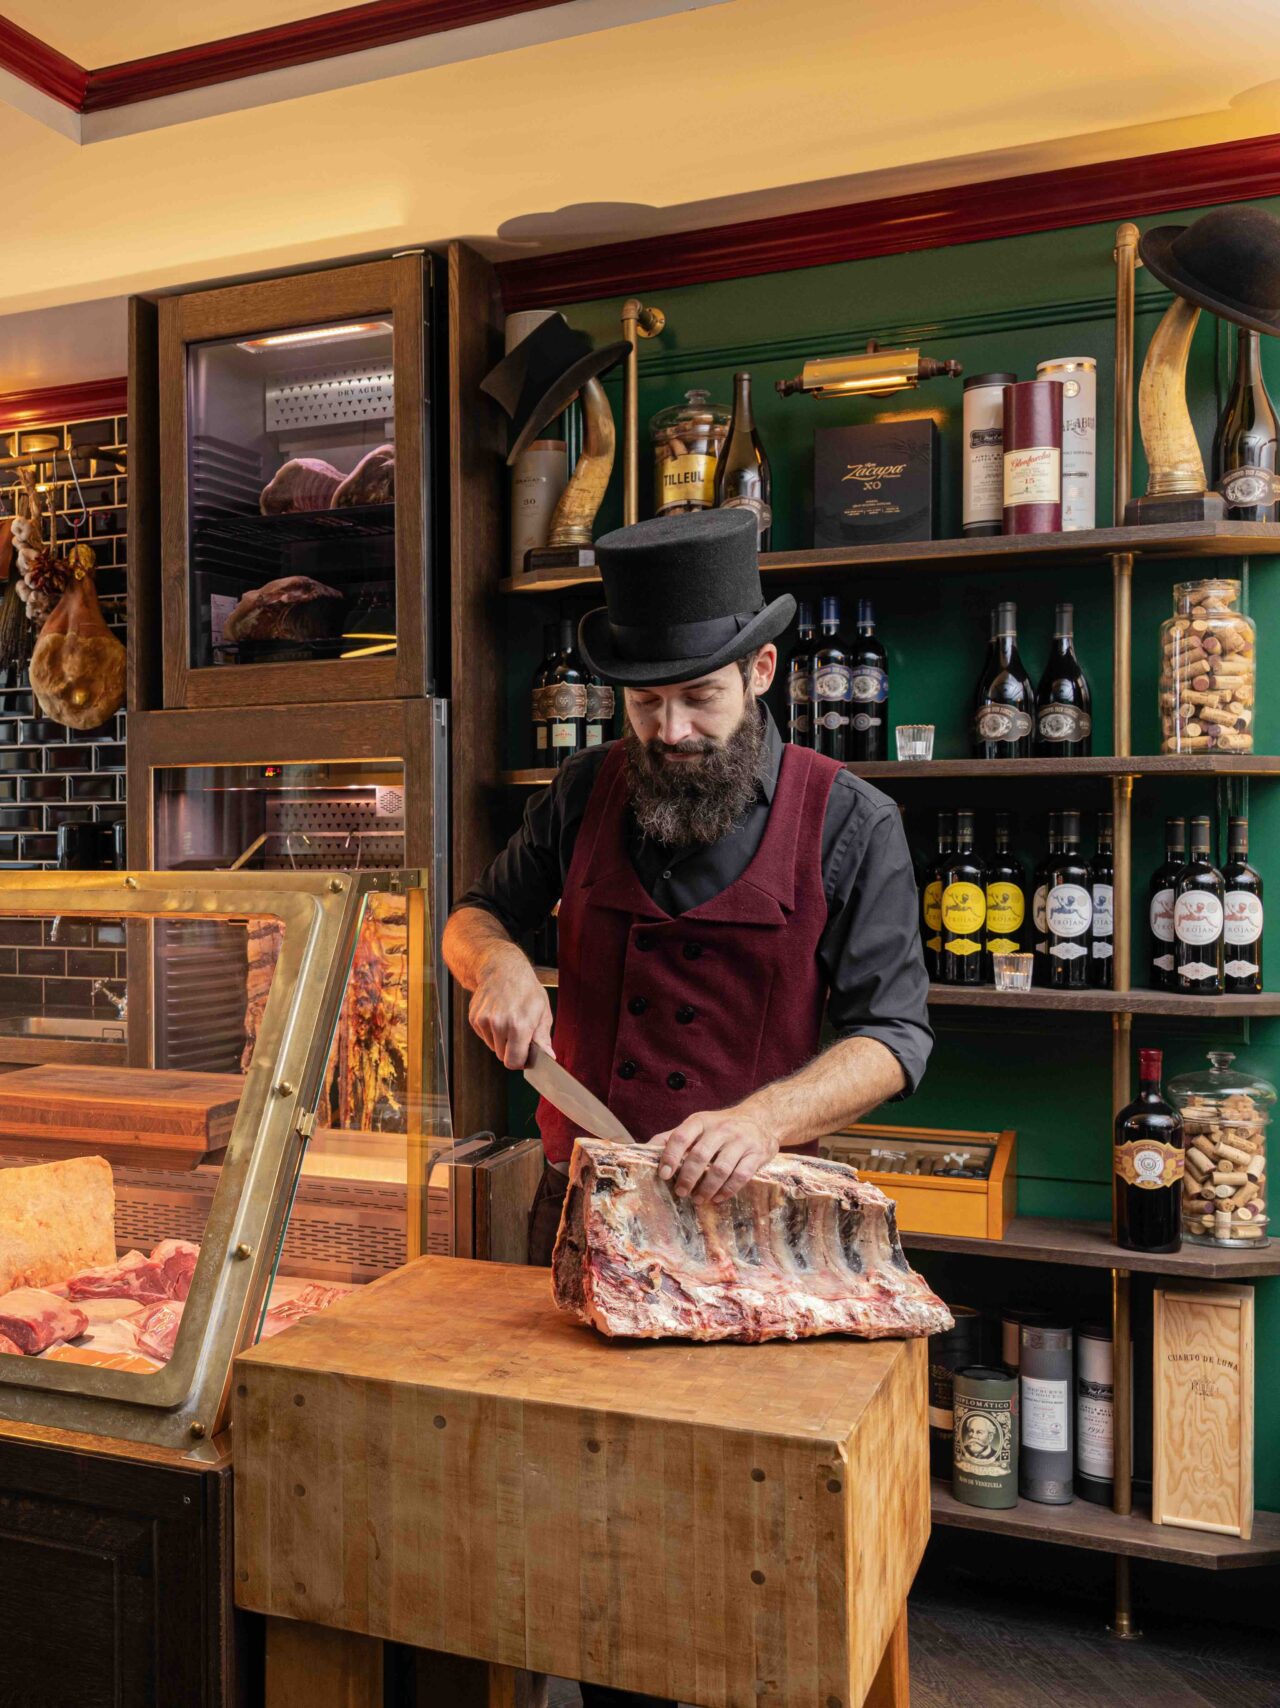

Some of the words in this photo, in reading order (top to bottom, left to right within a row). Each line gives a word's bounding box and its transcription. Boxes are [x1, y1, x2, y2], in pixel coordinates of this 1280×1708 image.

[337, 389, 355, 397] DRY
[358, 385, 383, 394] AGER
[841, 463, 907, 481] Zacapa
[663, 471, 705, 487] TILLEUL
[863, 480, 882, 491] XO
[1053, 919, 1084, 927] TROJAN
[1181, 926, 1214, 934] TROJAN
[1167, 1353, 1200, 1362] CUARTO
[1202, 1355, 1214, 1364] DE
[1216, 1357, 1239, 1372] LUNA
[975, 1480, 1003, 1488] VENEZUELA
